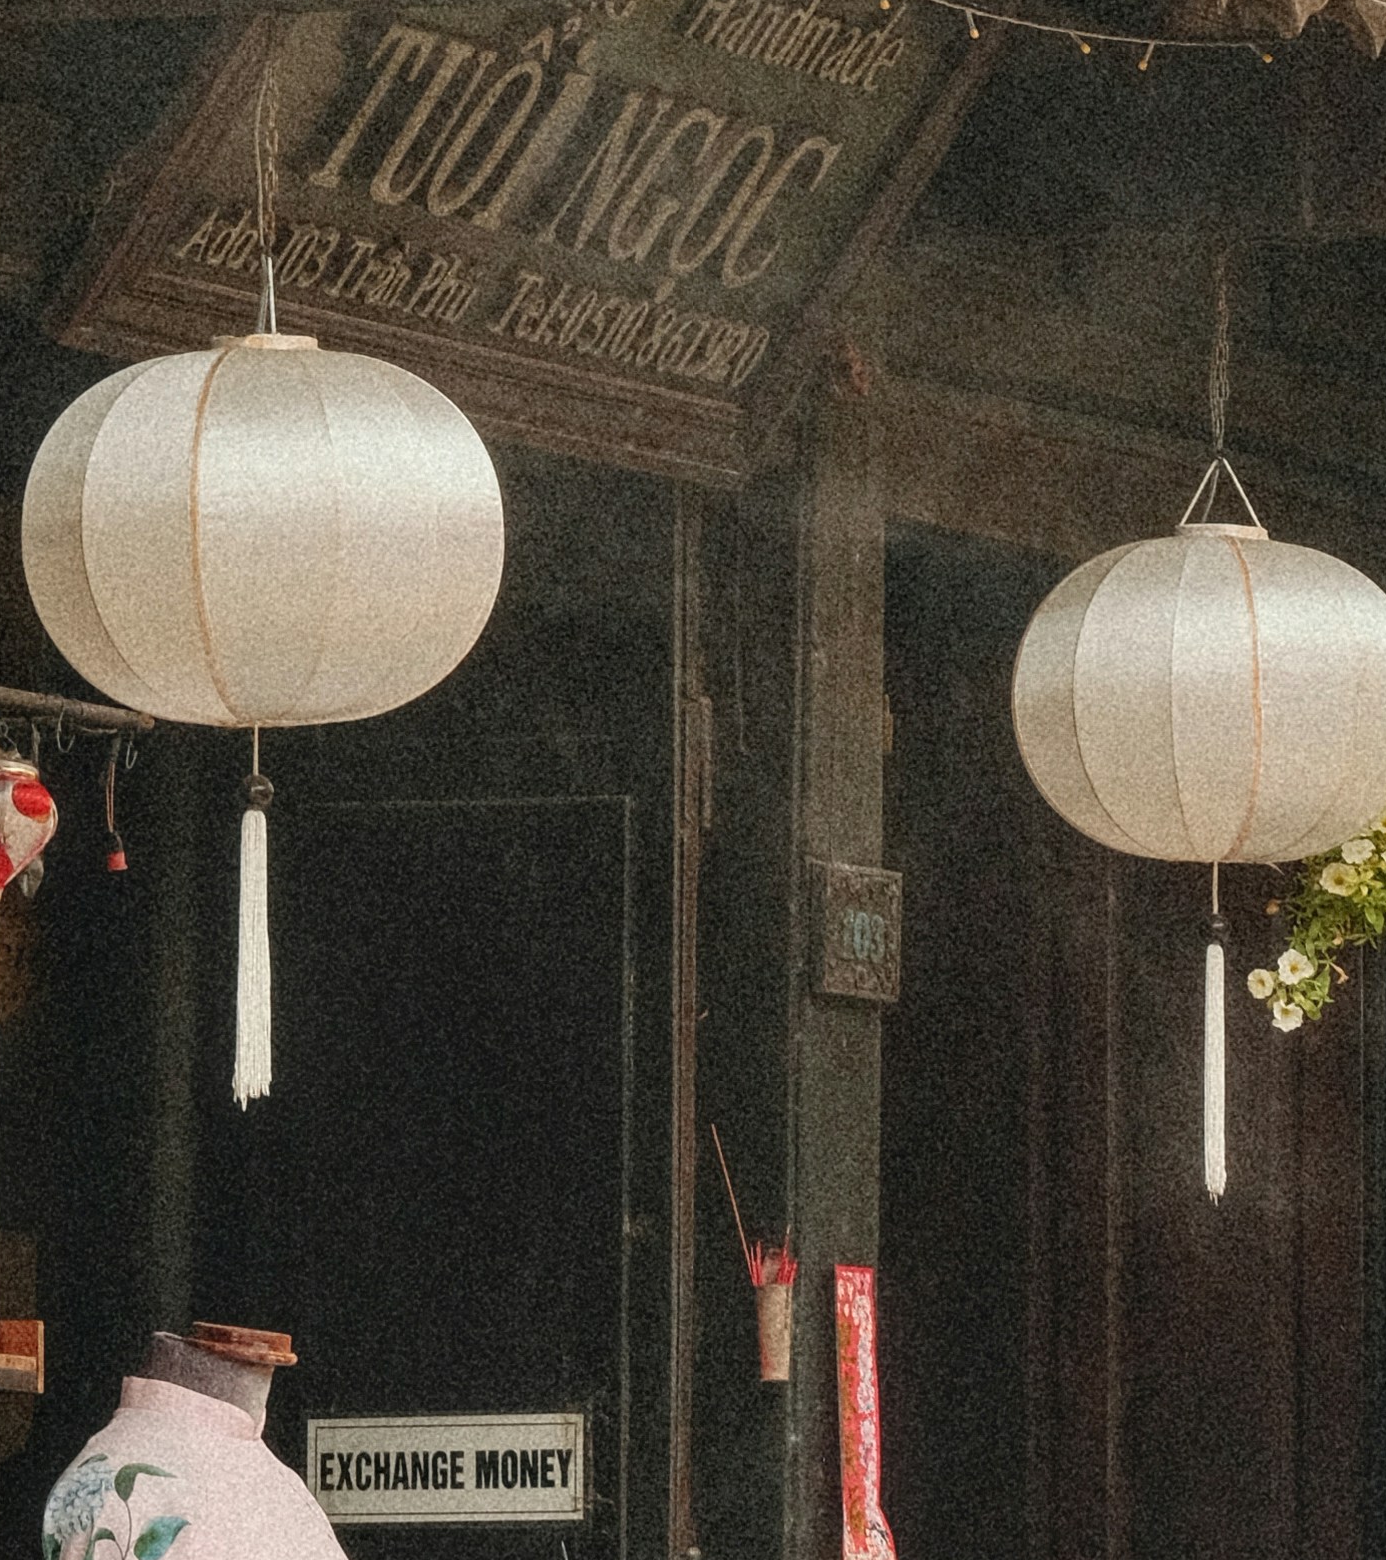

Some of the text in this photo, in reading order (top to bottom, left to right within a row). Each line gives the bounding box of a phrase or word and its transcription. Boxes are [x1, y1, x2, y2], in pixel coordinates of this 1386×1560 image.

[538, 88, 844, 304] NGỌC
[319, 1447, 573, 1492] EXCHANGE MONEY
